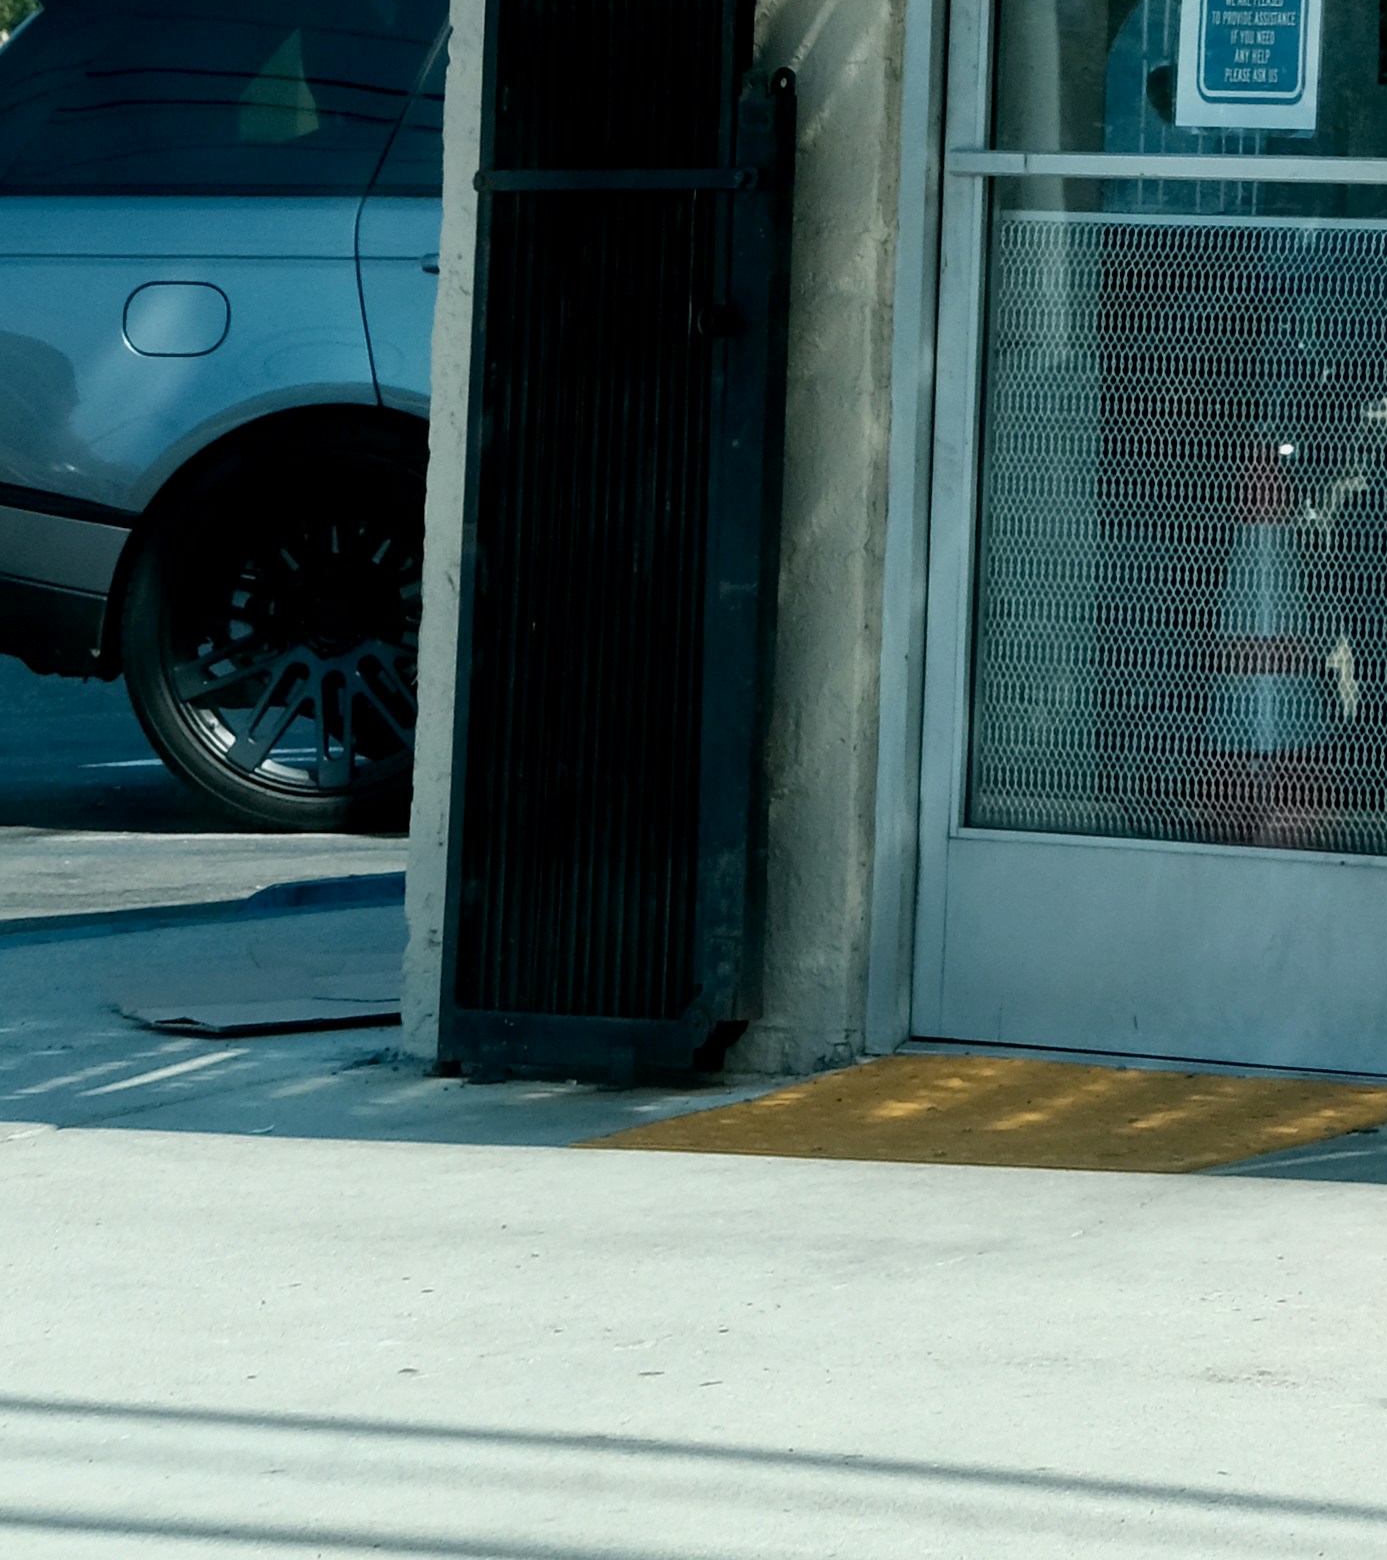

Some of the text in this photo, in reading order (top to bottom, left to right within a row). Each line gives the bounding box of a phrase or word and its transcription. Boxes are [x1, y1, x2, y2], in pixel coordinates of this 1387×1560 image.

[1256, 30, 1275, 45] NEED
[1252, 49, 1270, 64] HELP
[1225, 68, 1251, 83] PLEASE
